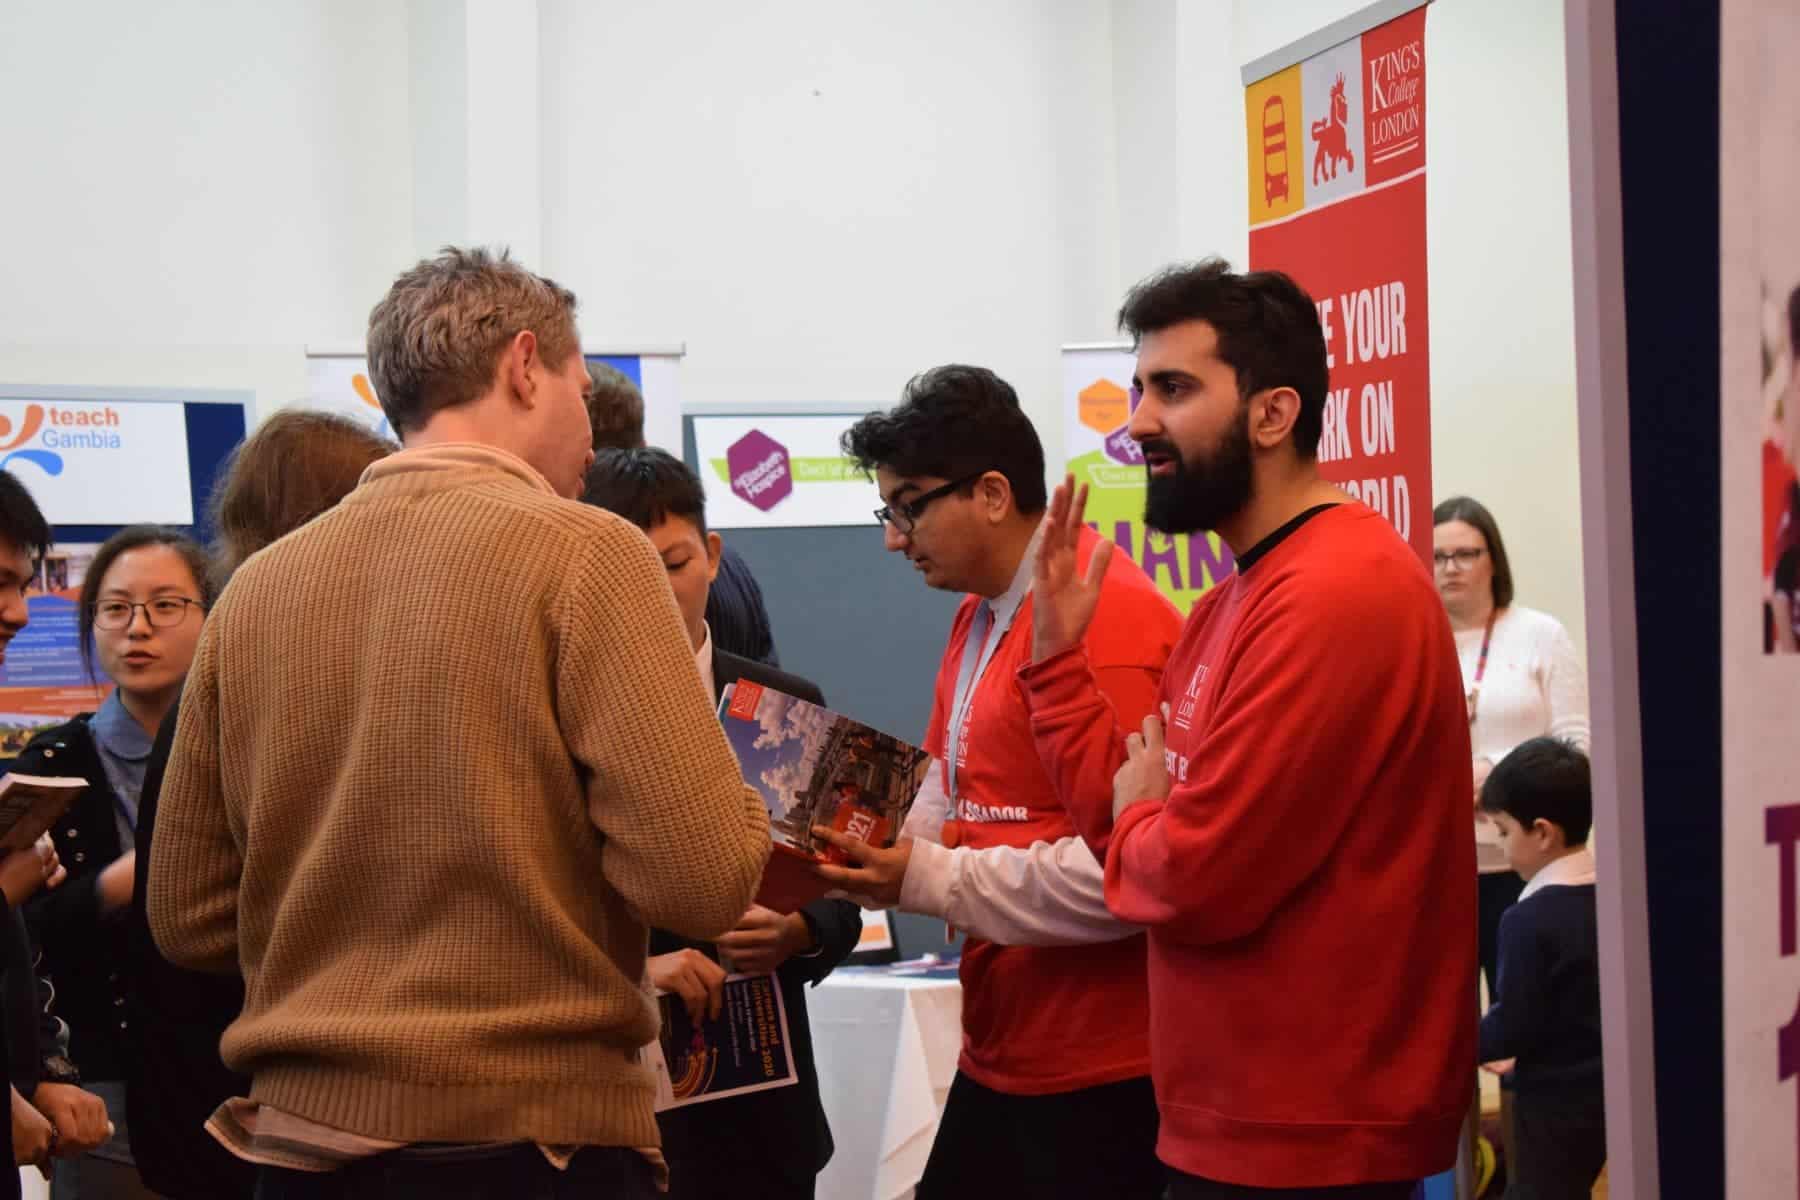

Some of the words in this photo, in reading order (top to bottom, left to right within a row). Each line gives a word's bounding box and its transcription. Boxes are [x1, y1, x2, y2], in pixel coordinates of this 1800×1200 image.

[1388, 75, 1419, 105] College
[1372, 103, 1419, 145] LONDON
[1340, 280, 1407, 365] YOUR
[49, 406, 120, 427] teach
[1317, 387, 1353, 464] RK
[1361, 380, 1395, 457] ON
[42, 429, 121, 449] Gambia
